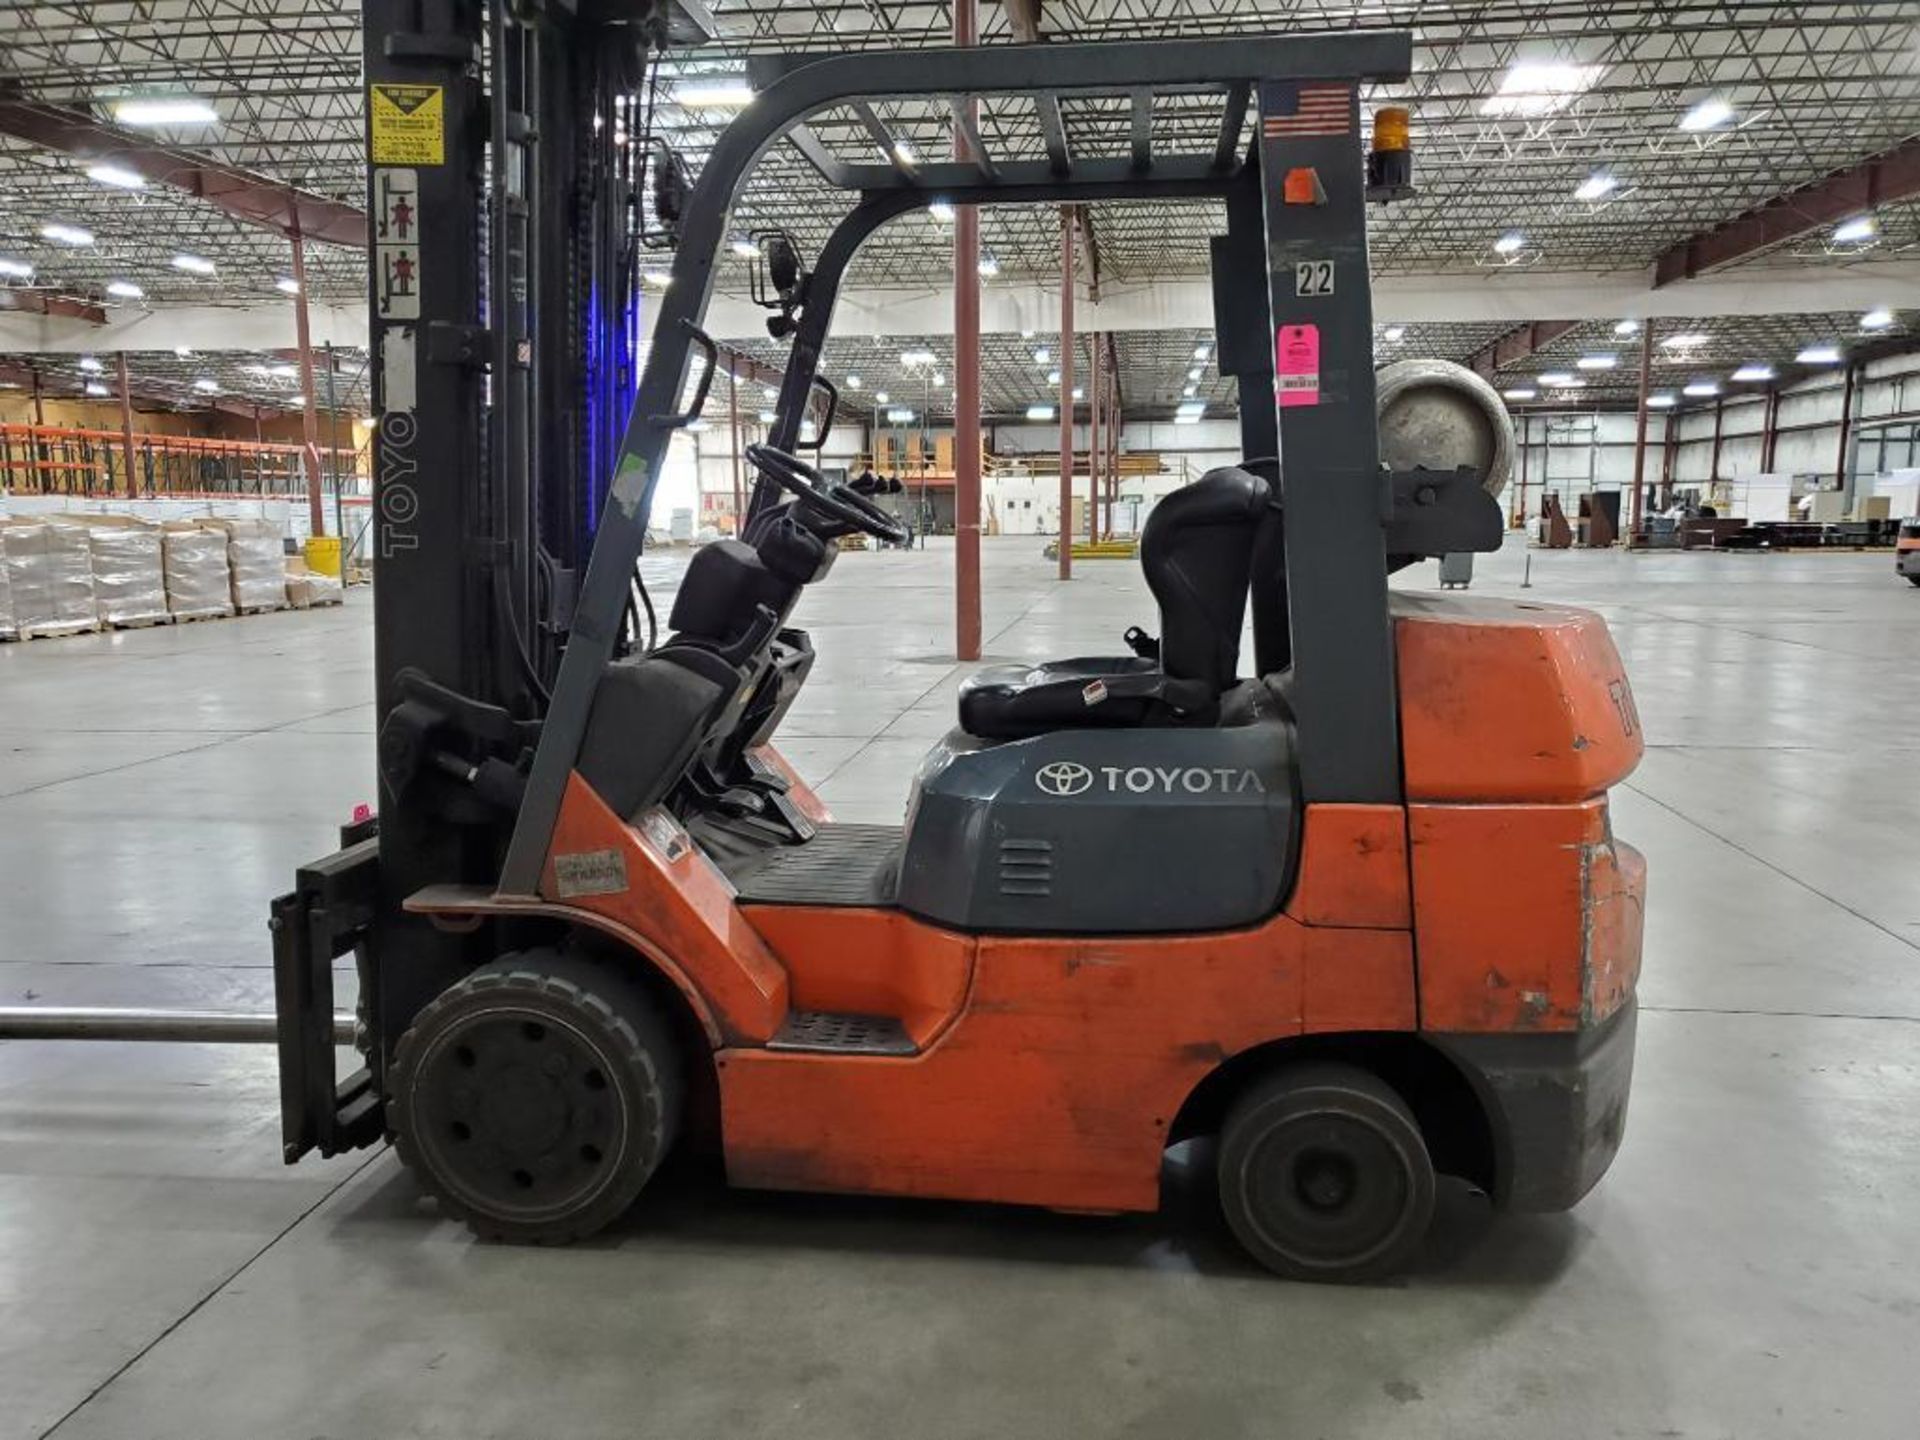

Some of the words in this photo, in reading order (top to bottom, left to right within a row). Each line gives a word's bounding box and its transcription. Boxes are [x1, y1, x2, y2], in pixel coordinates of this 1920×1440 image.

[1299, 264, 1331, 294] 22
[380, 340, 419, 558] TOYO
[1101, 767, 1266, 793] TOYOTA
